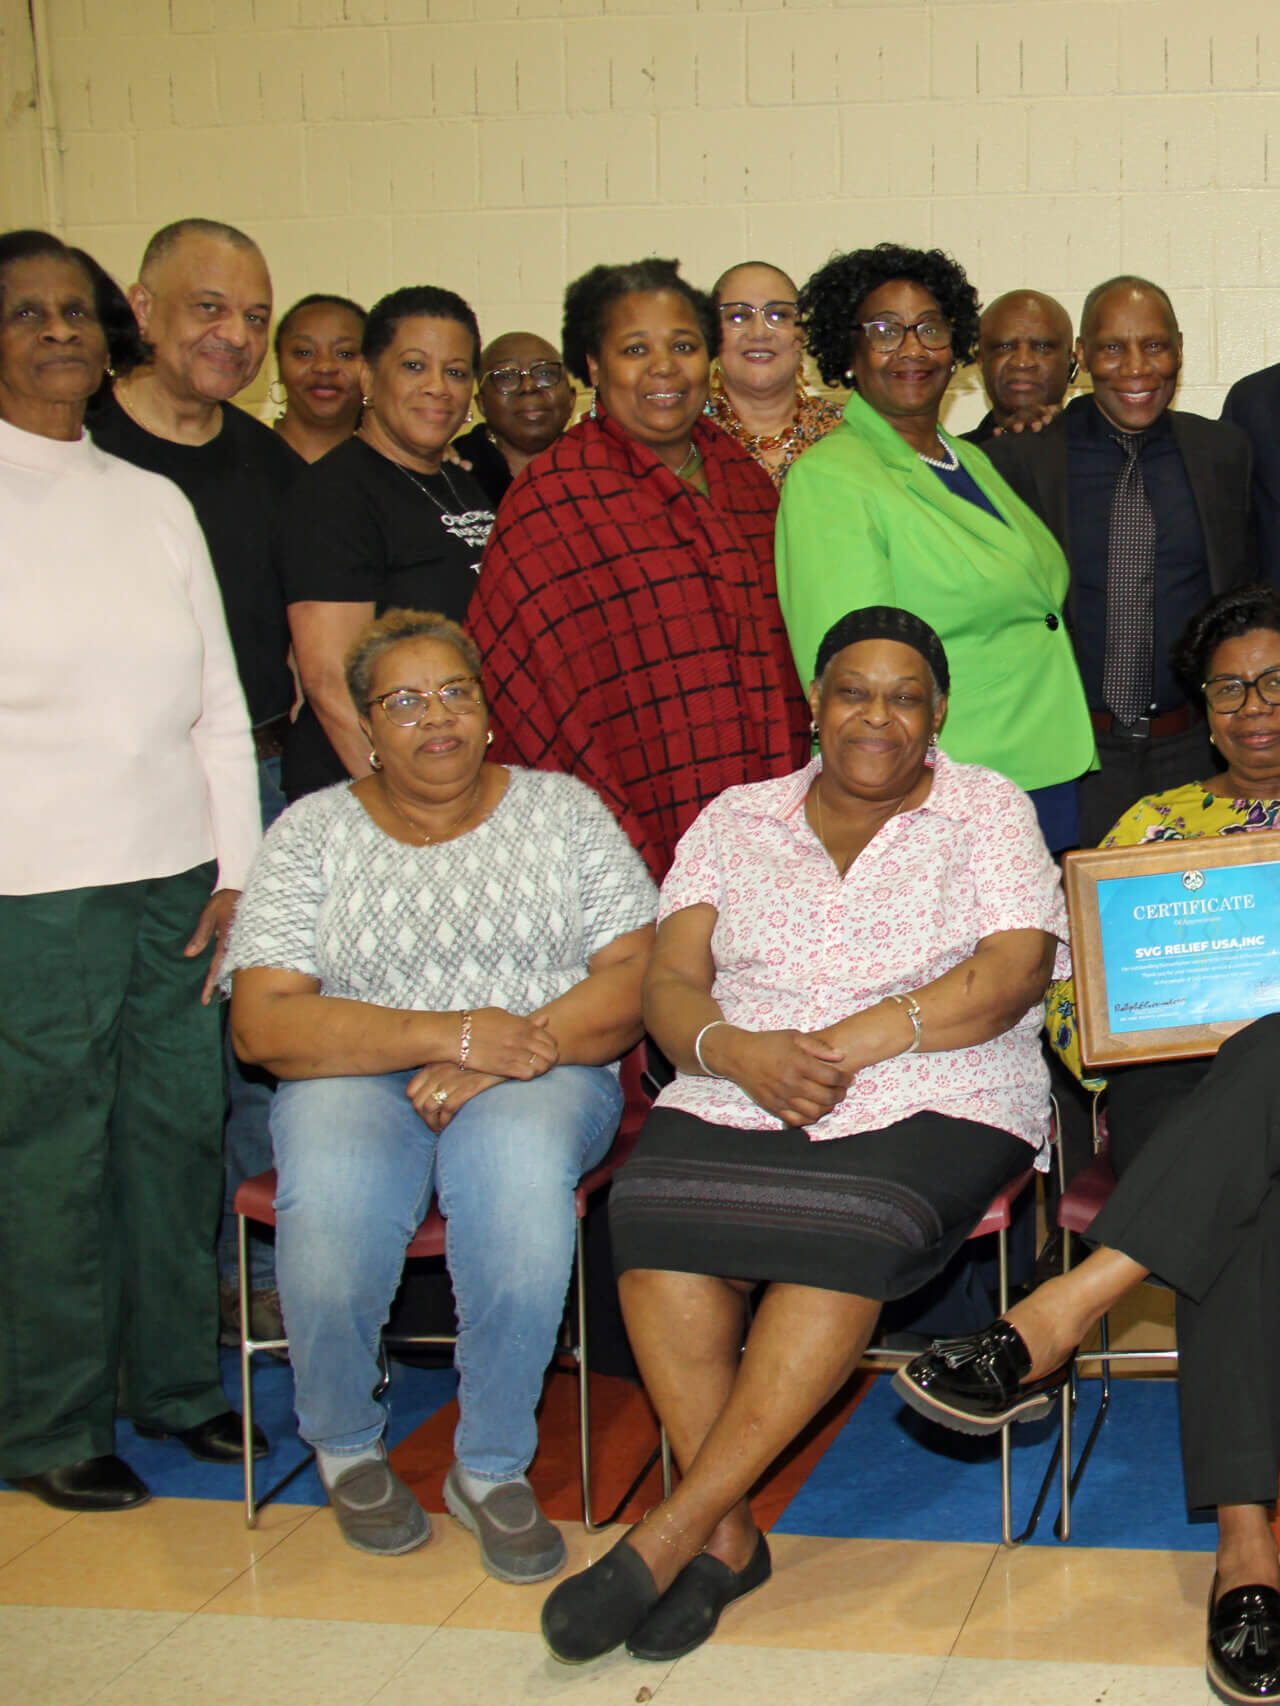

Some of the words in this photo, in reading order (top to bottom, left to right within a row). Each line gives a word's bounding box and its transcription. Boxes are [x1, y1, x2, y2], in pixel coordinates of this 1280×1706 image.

[1133, 894, 1256, 921] CERTIFICATE
[1135, 945, 1162, 959] SVG
[1164, 941, 1209, 955] RELIEF
